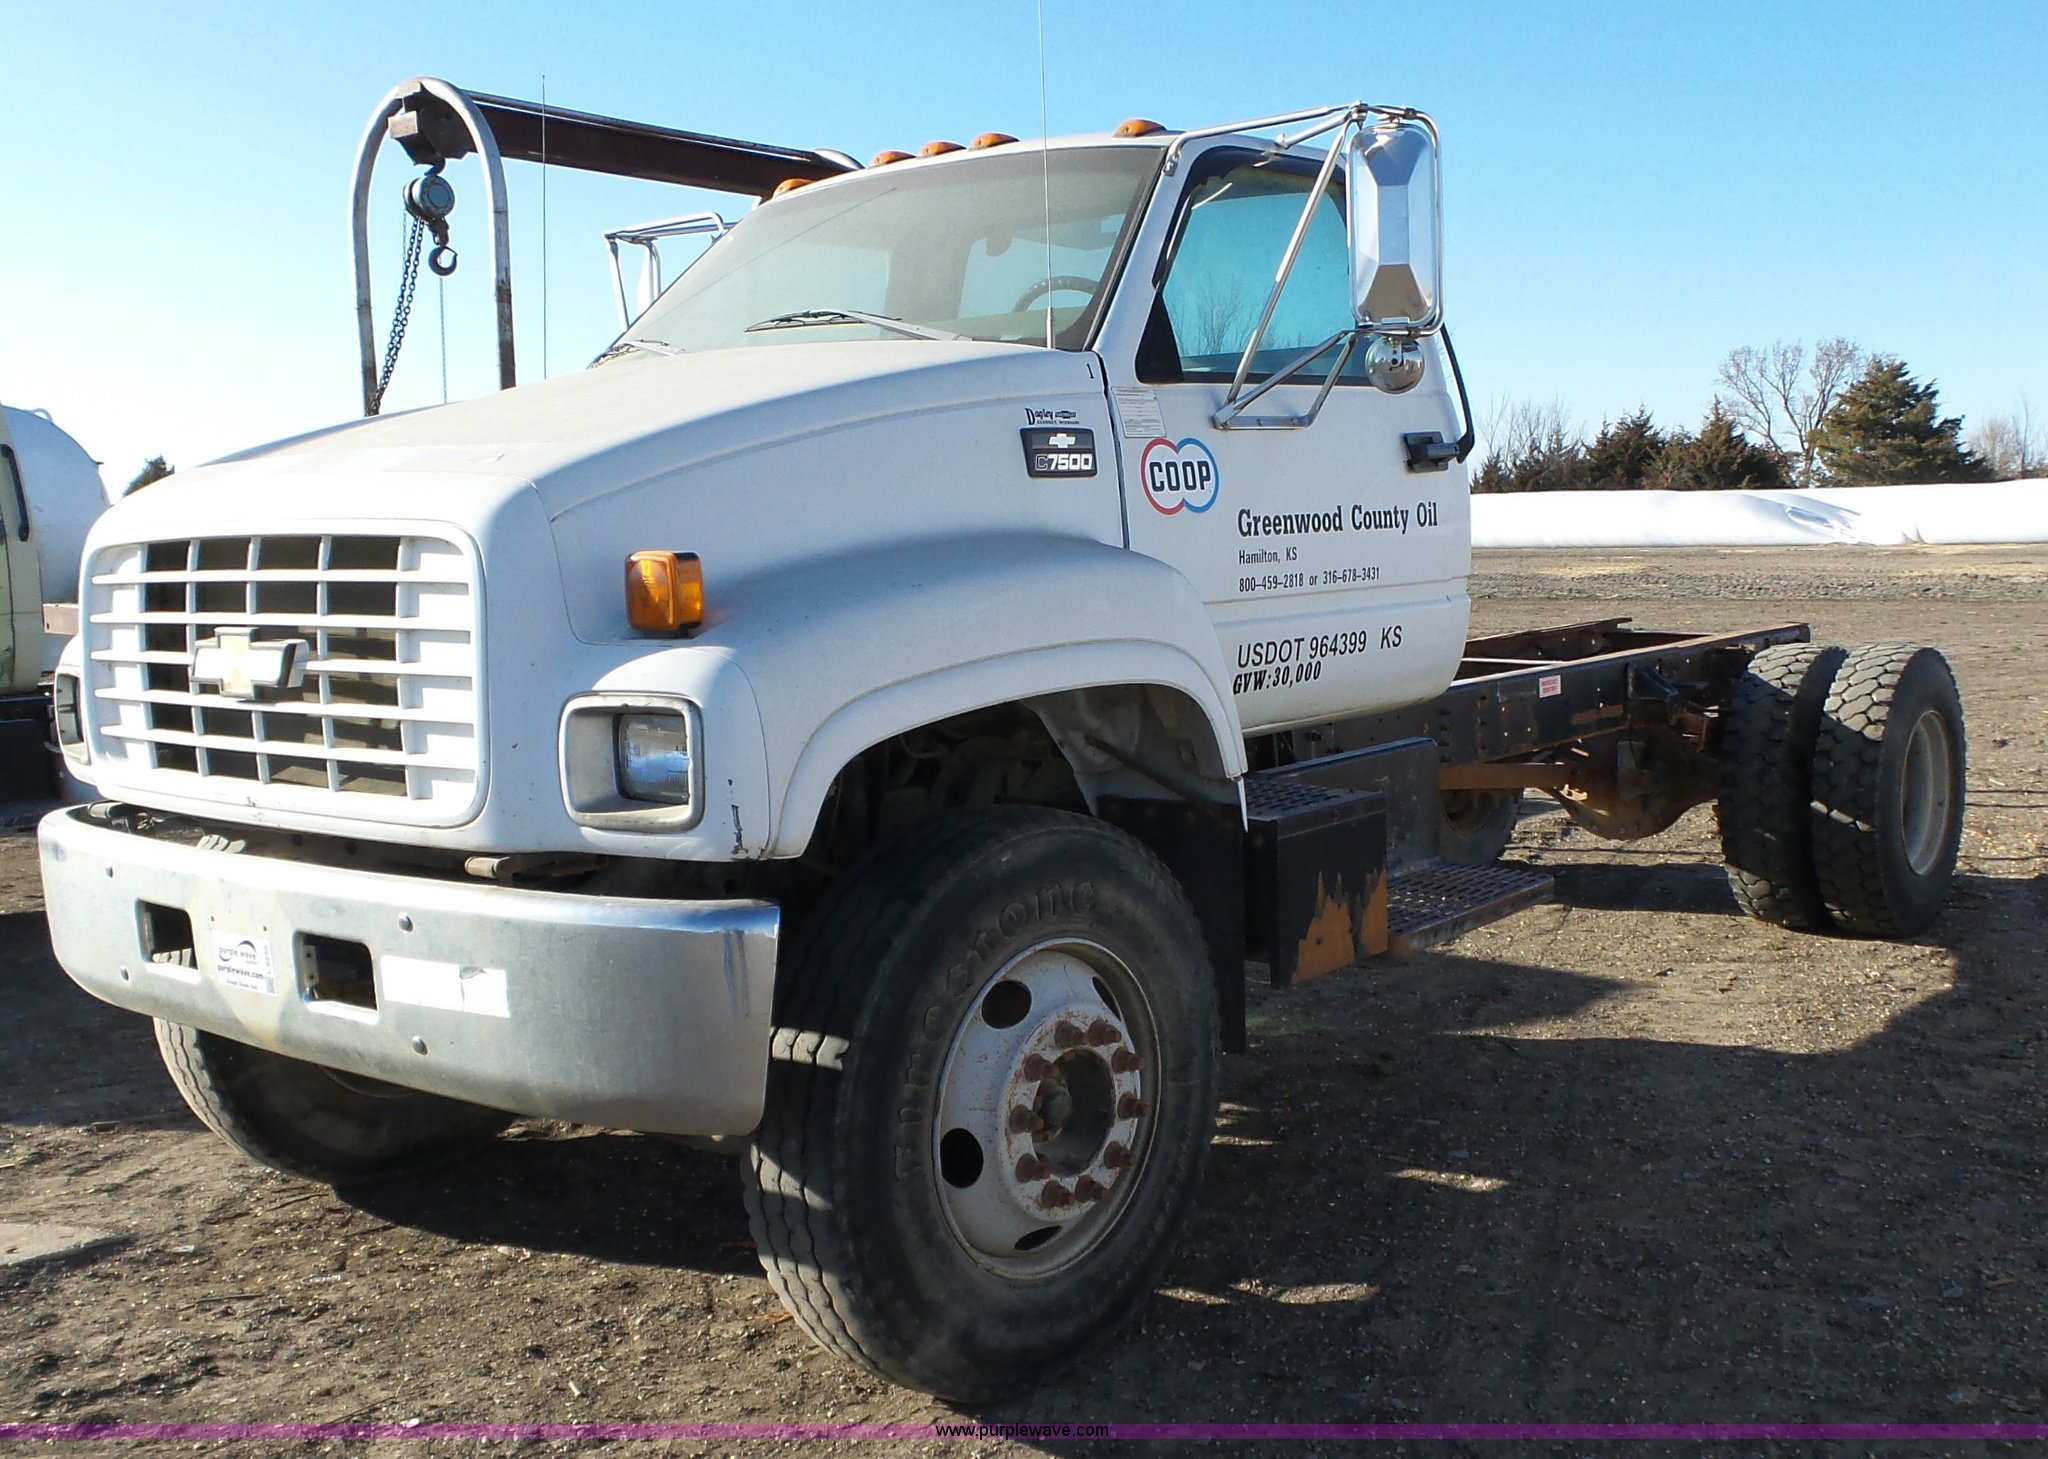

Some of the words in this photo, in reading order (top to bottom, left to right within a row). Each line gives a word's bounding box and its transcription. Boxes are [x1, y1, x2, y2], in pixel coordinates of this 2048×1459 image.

[1035, 453, 1093, 471] C7500
[1149, 460, 1211, 492] COOP
[1237, 505, 1344, 538] Greenwood
[1351, 504, 1409, 535] County
[1416, 502, 1438, 527] Oil
[1239, 549, 1281, 564] Hamilton,
[1285, 547, 1298, 561] KS
[1239, 572, 1304, 592] 800-459-2818
[1309, 575, 1318, 586] or
[1322, 566, 1380, 585] 316-678-3431
[1237, 637, 1305, 669] USDOT
[1308, 630, 1367, 660] 964399
[1380, 625, 1403, 650] KS
[1232, 660, 1322, 695] GVW:30,000
